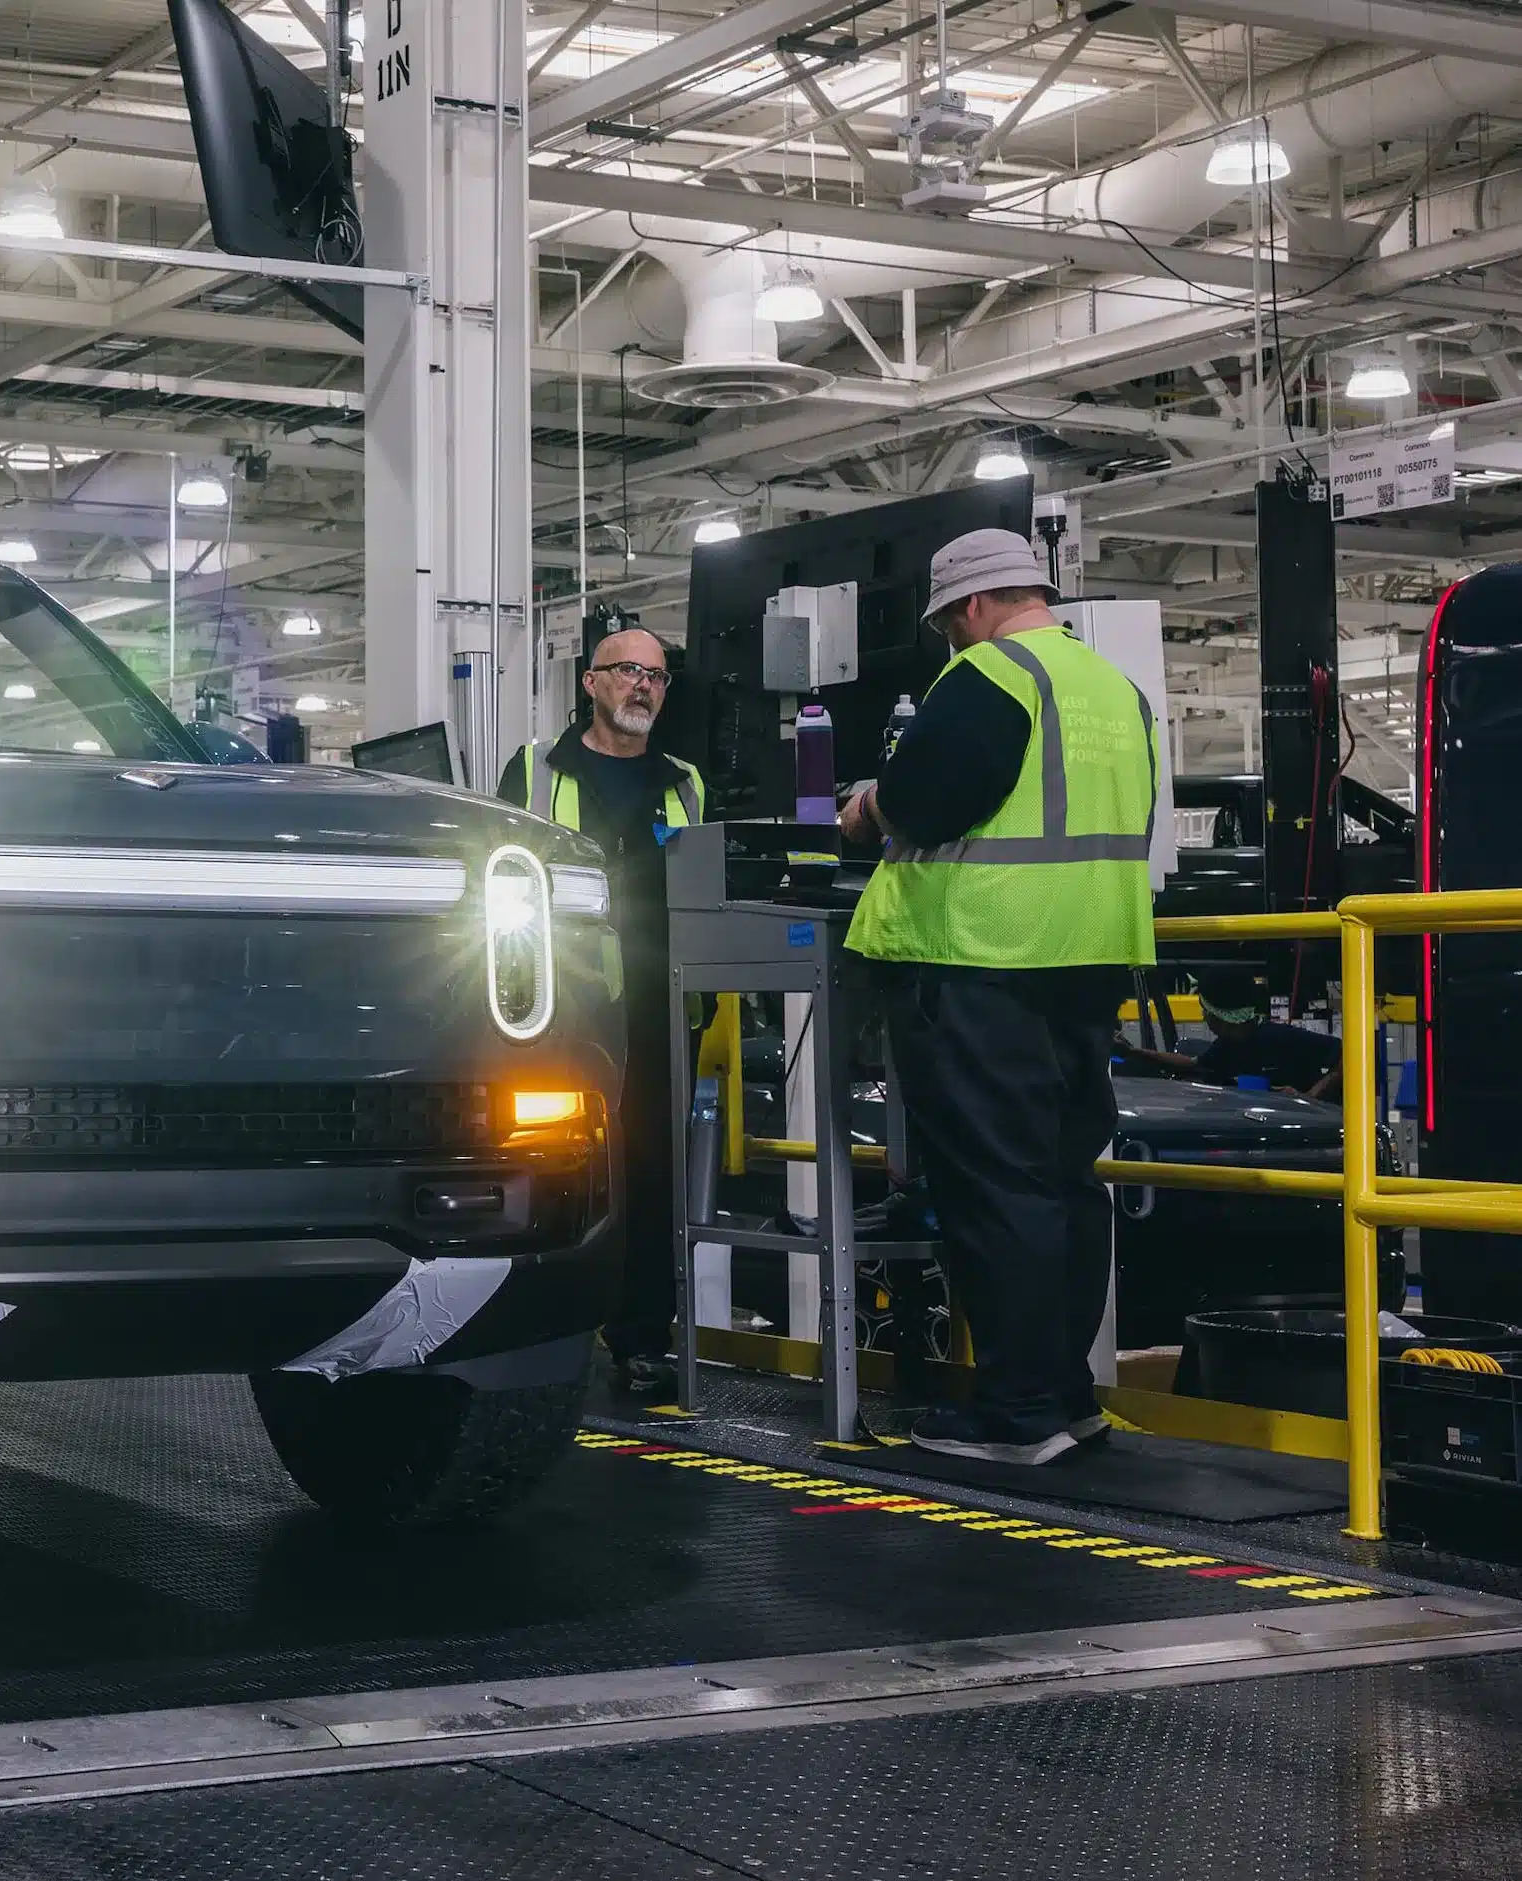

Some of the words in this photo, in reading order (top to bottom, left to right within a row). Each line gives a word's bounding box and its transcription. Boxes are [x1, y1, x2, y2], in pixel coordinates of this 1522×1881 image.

[378, 44, 410, 102] 11N
[1404, 441, 1431, 452] Common
[1349, 451, 1375, 462] Common
[1334, 467, 1383, 486] PT00101118
[1453, 1452, 1482, 1464] RIVIAN
